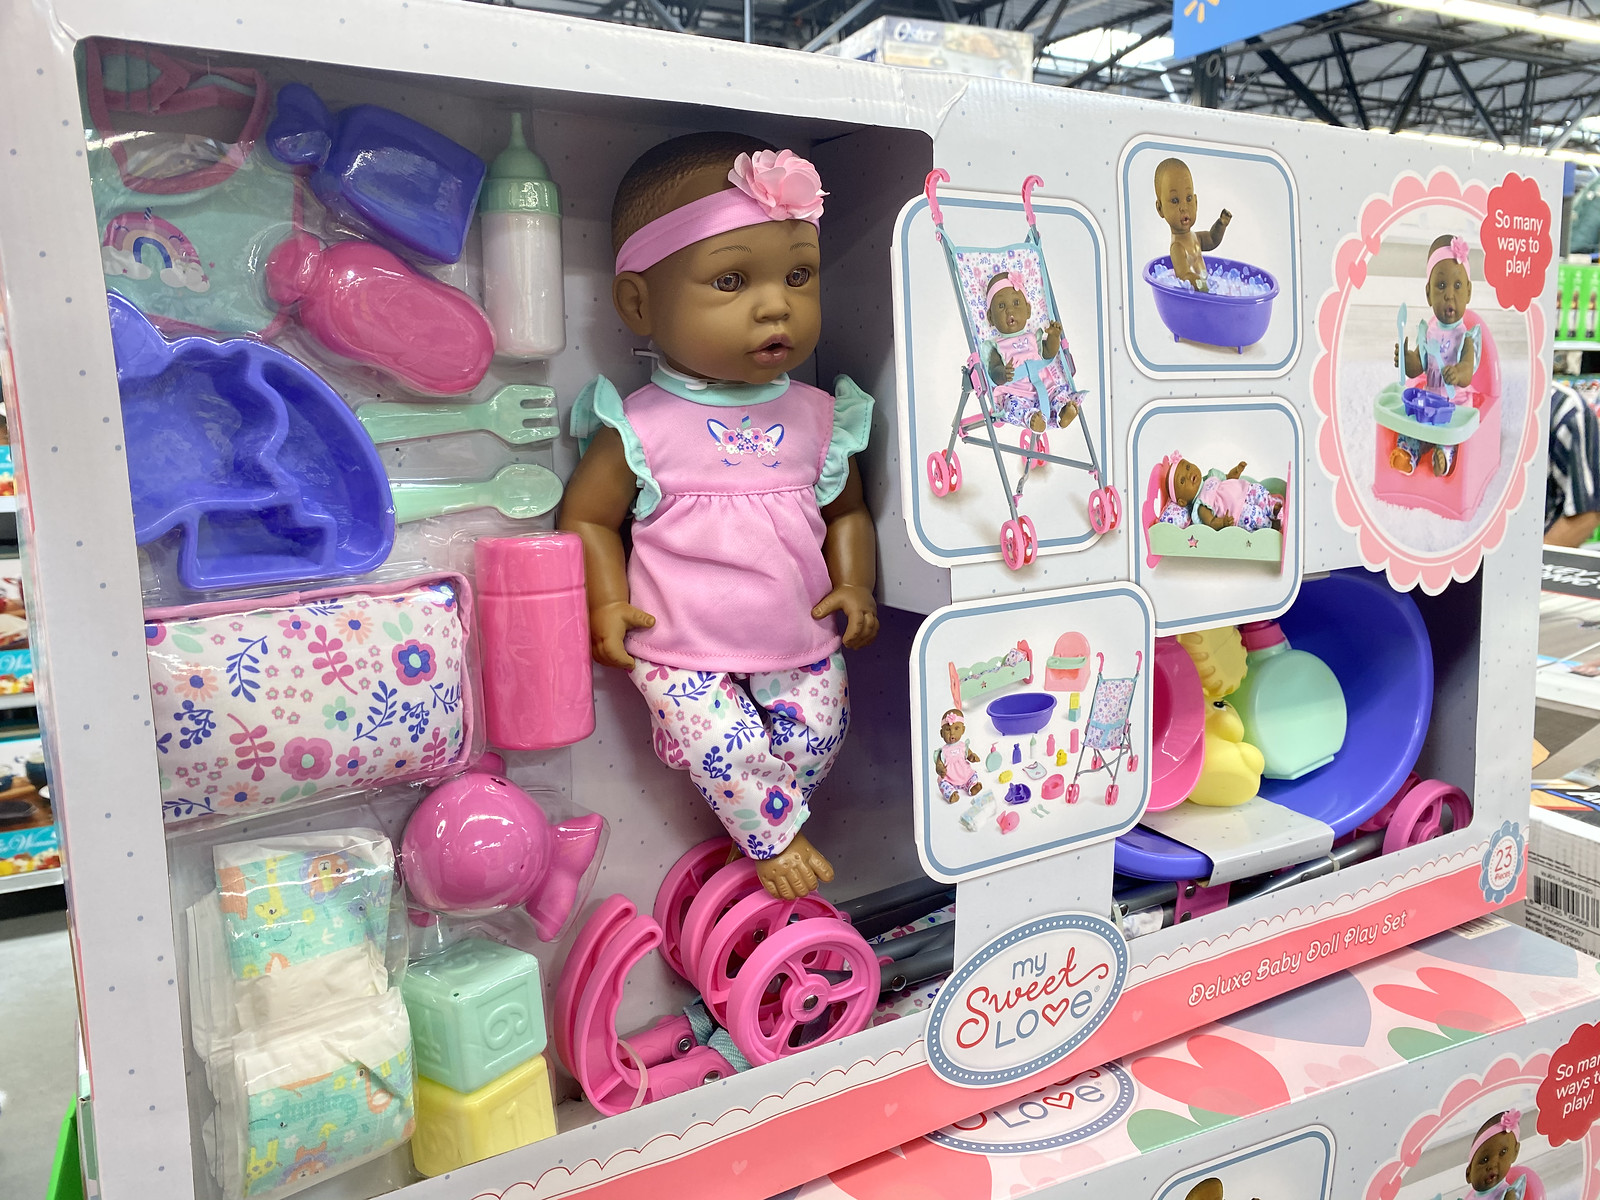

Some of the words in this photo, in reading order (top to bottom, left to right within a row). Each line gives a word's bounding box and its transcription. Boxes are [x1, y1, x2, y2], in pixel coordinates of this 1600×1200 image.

[894, 21, 937, 42] Oster
[1495, 209, 1511, 229] So
[1513, 216, 1543, 236] many
[1497, 236, 1526, 255] ways
[1529, 236, 1540, 254] to
[1506, 256, 1531, 278] play!
[1494, 845, 1513, 872] 23
[1012, 952, 1047, 980] my
[1188, 969, 1252, 1006] Deluxe
[1256, 951, 1302, 982] Baby
[1306, 932, 1340, 962] Doll
[1344, 923, 1379, 948] Play
[1382, 910, 1408, 934] Set
[956, 946, 1109, 1049] Sweet
[1555, 1063, 1574, 1081] So
[1556, 1075, 1594, 1100] ways
[1563, 1089, 1595, 1119] play!
